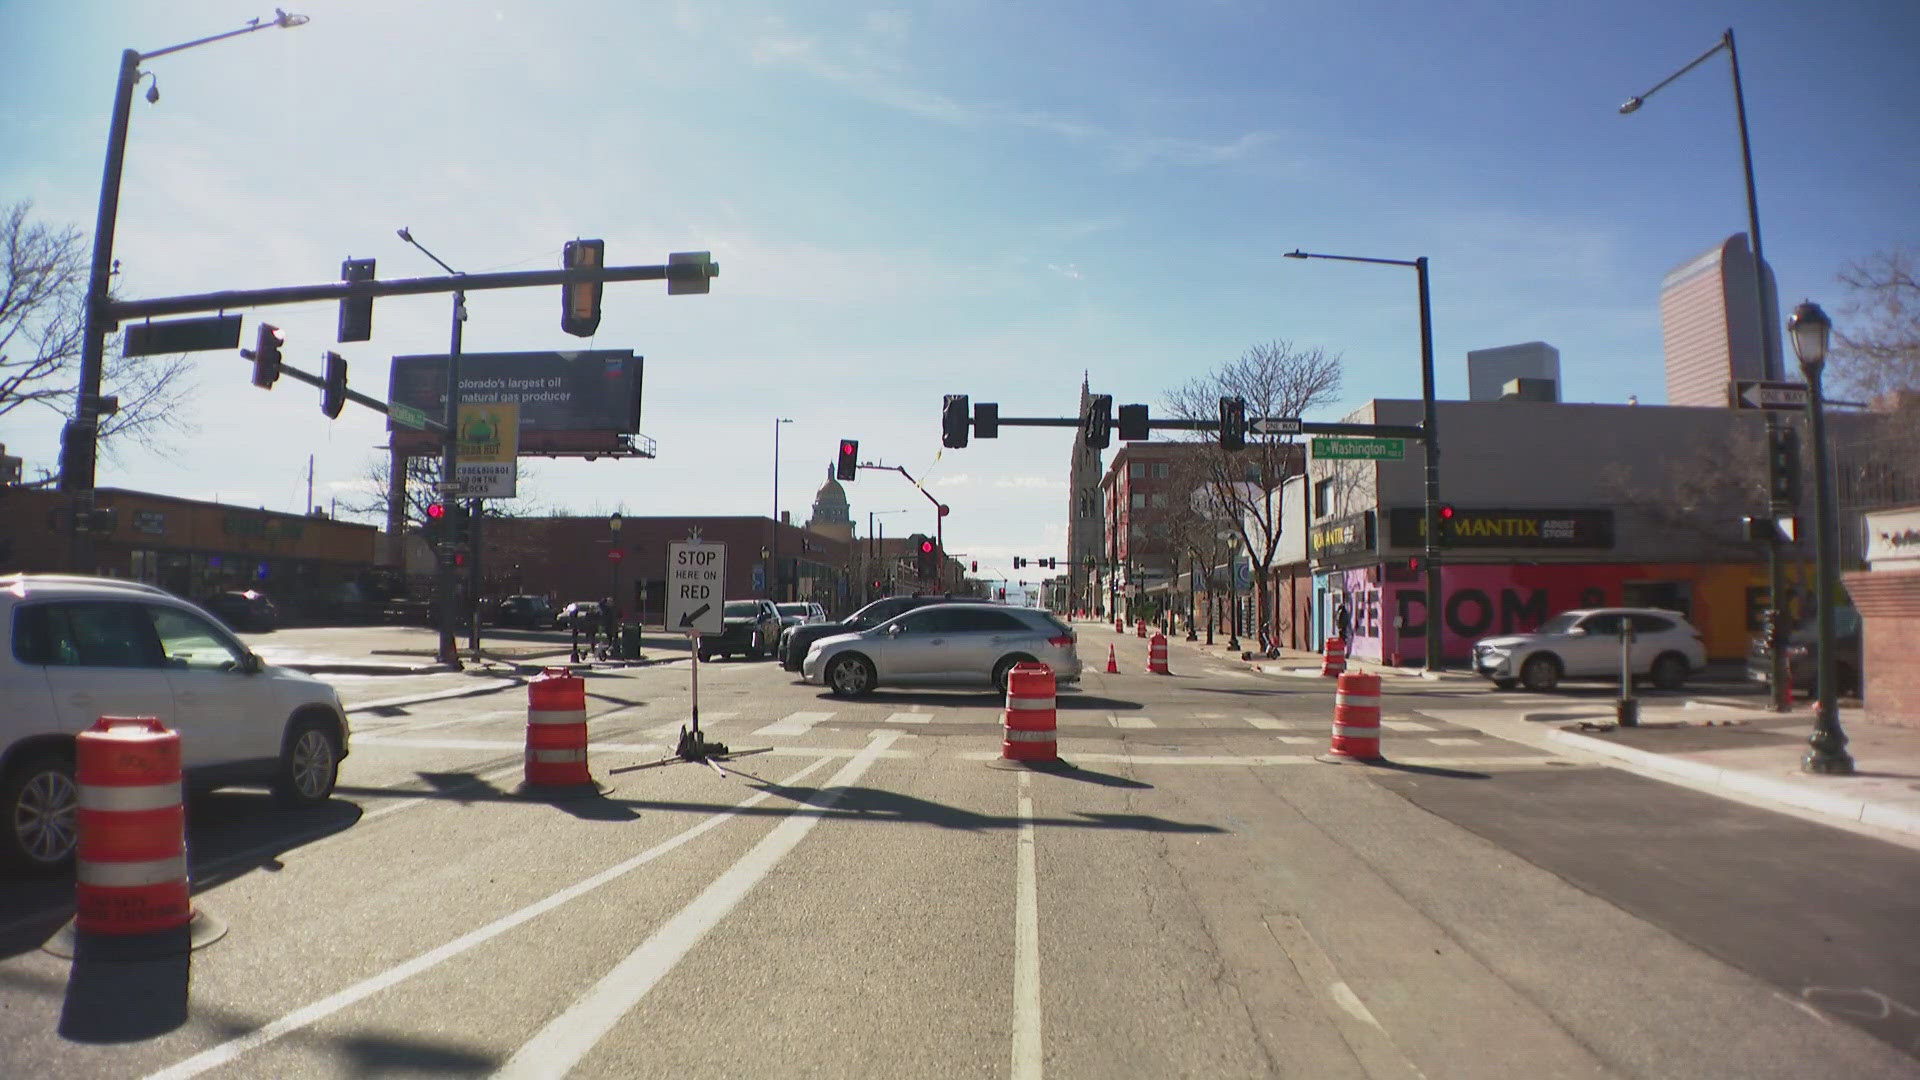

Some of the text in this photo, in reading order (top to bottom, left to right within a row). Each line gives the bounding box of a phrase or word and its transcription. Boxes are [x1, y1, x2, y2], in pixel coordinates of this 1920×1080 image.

[458, 377, 561, 390] olorado's largest oil
[461, 392, 498, 403] natural
[500, 392, 520, 404] gas
[521, 390, 571, 403] producer
[1761, 390, 1804, 401] ONE WAY
[1265, 421, 1297, 430] ONE WAY
[1330, 441, 1387, 458] Washington
[1420, 518, 1538, 537] RMANTIX
[678, 551, 716, 565] STOP
[676, 570, 717, 580] HERE ON
[680, 585, 710, 599] RED
